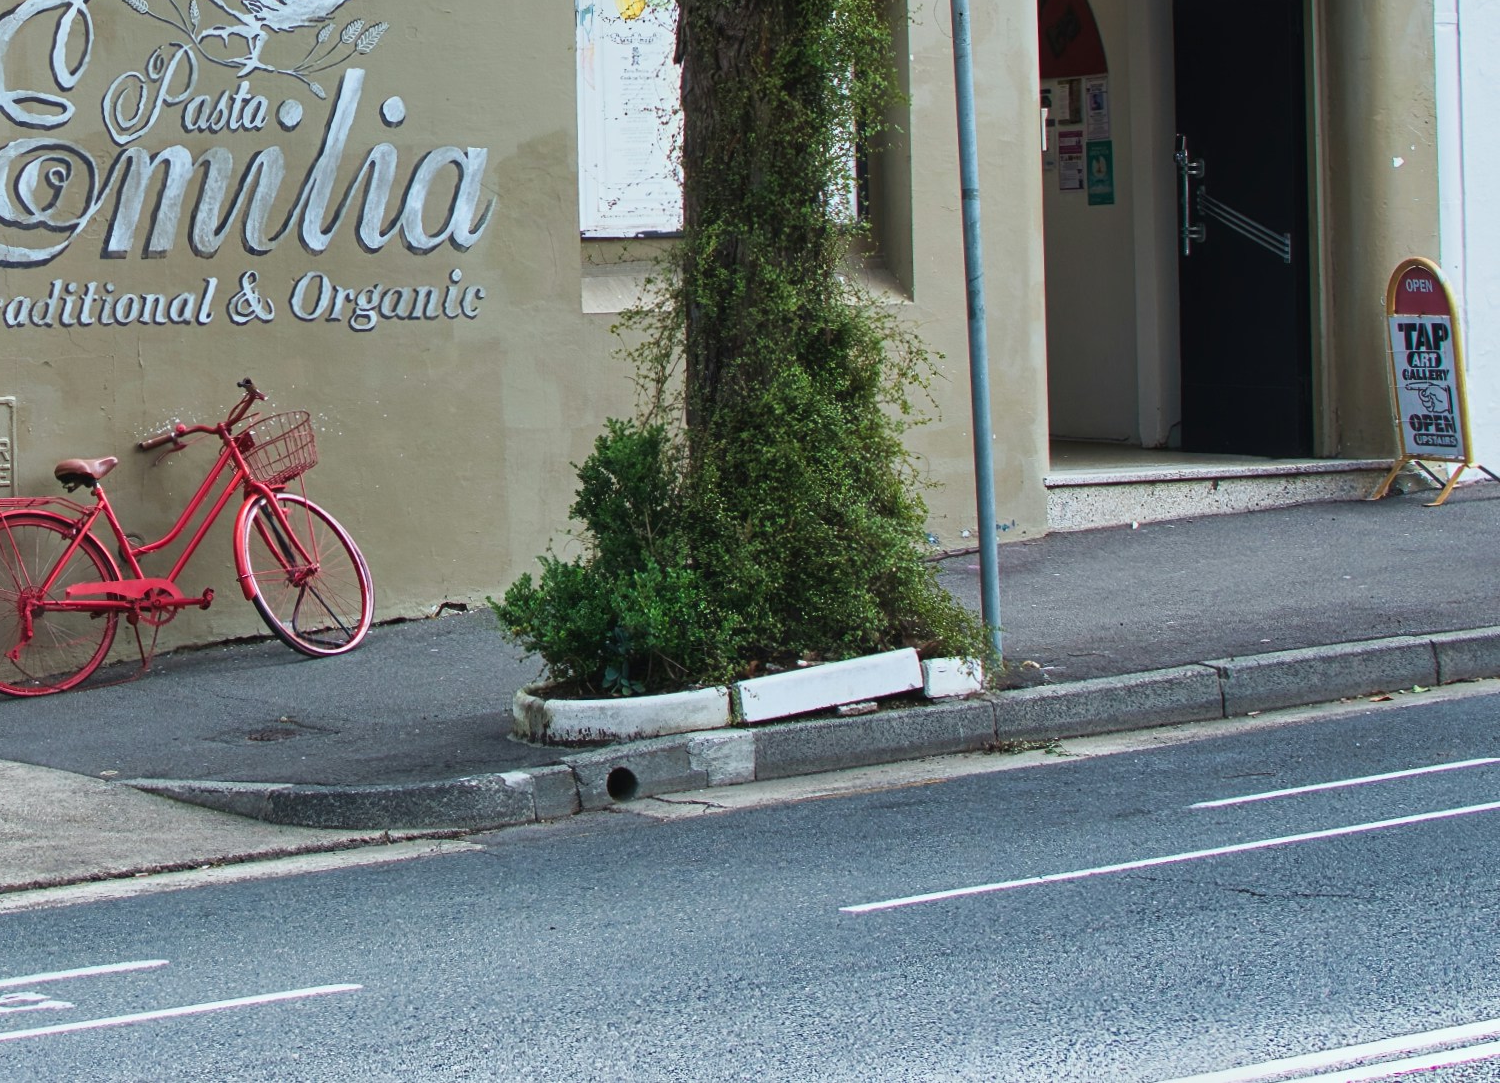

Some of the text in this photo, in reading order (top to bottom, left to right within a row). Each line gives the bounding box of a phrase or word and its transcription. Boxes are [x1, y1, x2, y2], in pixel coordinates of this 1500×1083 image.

[102, 42, 269, 144] Pasta
[1406, 278, 1433, 293] OPEN
[228, 271, 274, 322] &
[290, 269, 486, 332] Organic
[1398, 322, 1449, 350] TAP
[1411, 352, 1438, 367] ART
[1402, 368, 1449, 381] GALLERY
[1409, 413, 1456, 434] OPEN
[1416, 435, 1457, 447] UPSTAIRS
